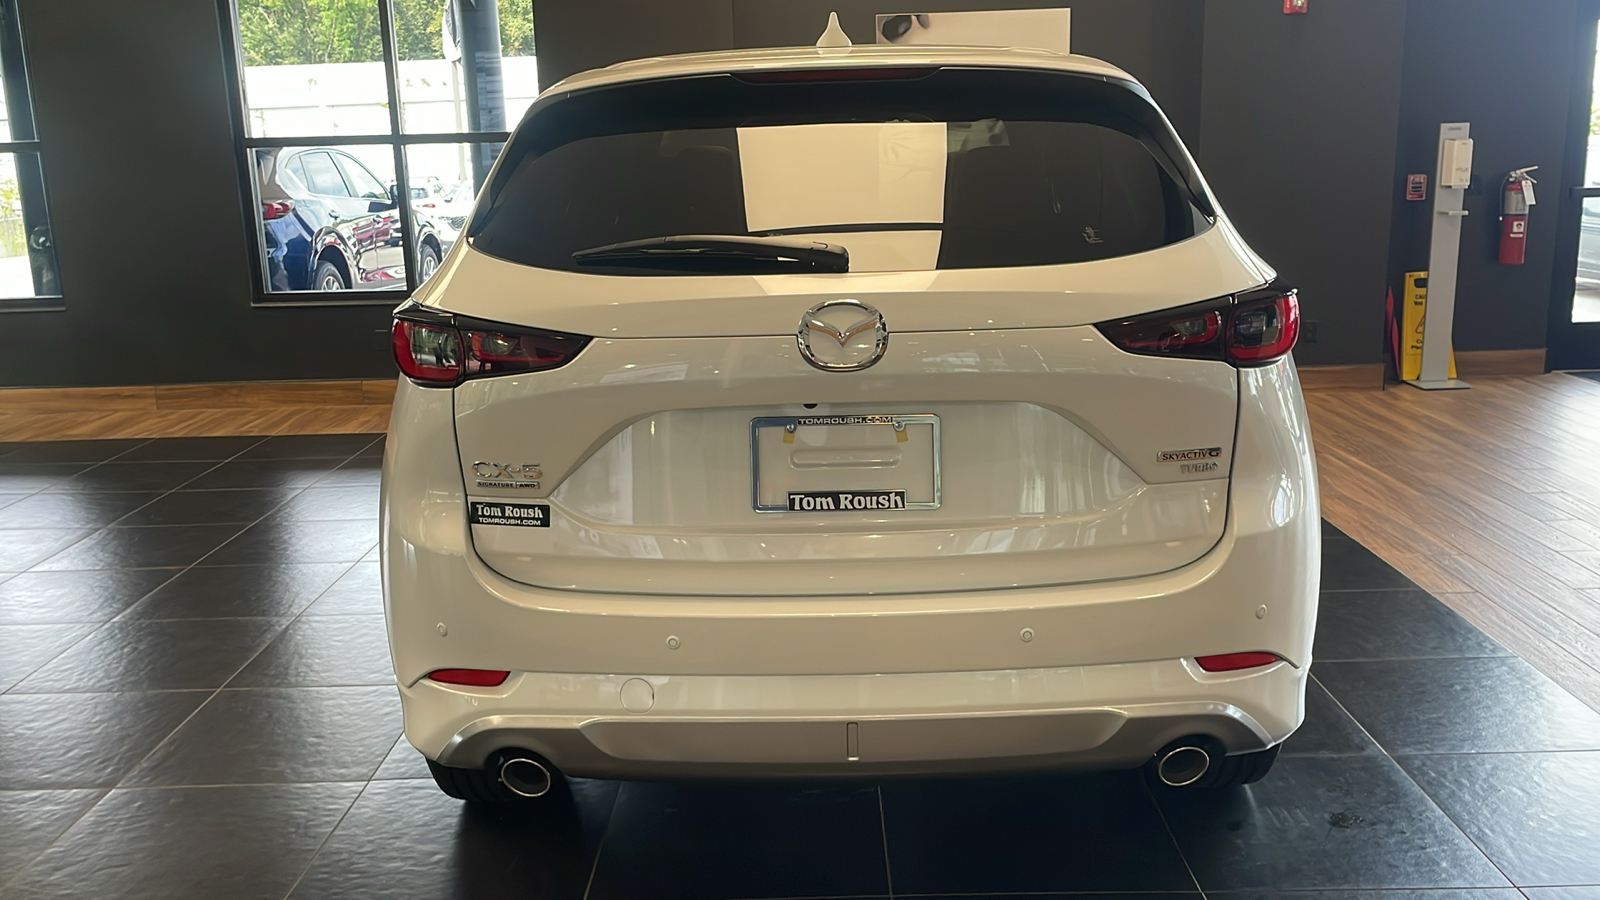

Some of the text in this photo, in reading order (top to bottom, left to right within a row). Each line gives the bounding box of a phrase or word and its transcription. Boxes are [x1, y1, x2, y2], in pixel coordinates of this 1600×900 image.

[798, 416, 893, 425] TOMROUSH.COM
[471, 460, 542, 479] CX-5
[790, 492, 904, 510] Tom Roush
[476, 504, 543, 518] Tom Roush
[479, 517, 541, 526] TOMROUSH.COM
